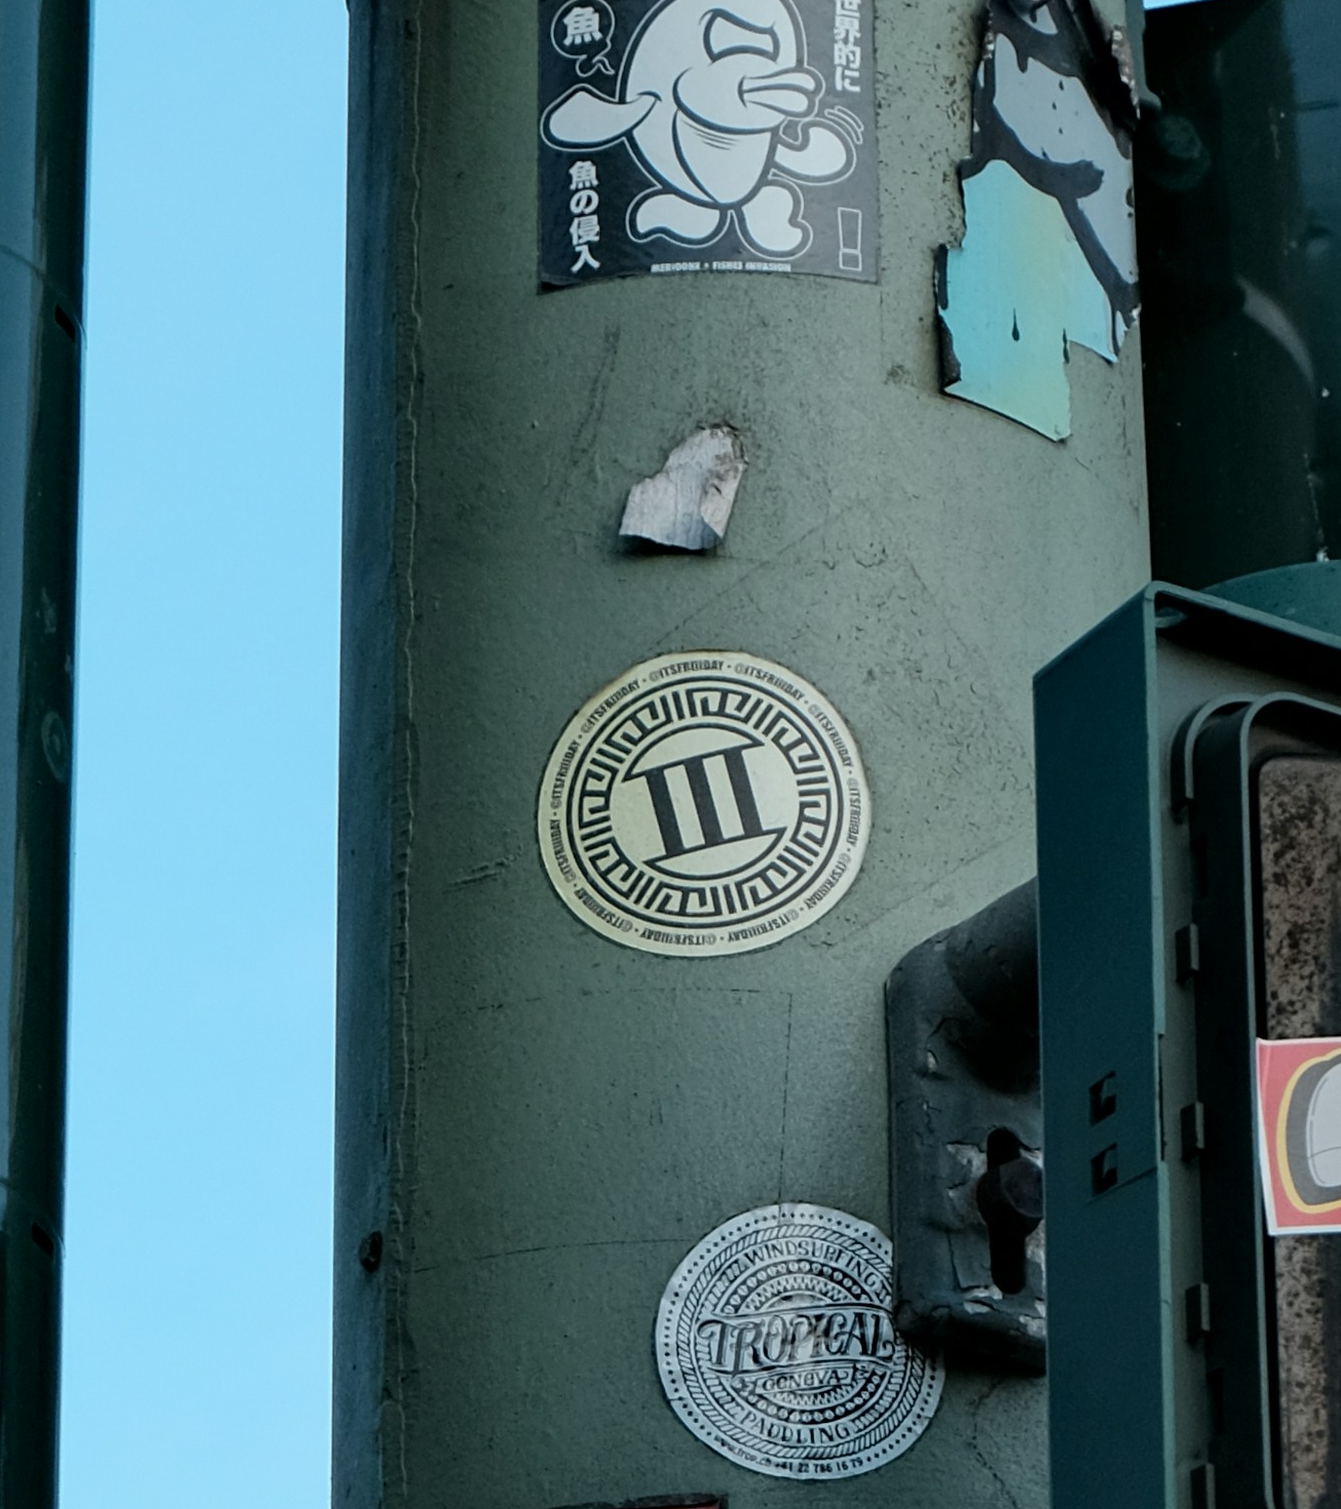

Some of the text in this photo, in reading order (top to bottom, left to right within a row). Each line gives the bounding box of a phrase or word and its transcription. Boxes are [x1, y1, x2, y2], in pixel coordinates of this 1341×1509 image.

[563, 6, 602, 46] 魚
[569, 160, 600, 273] 魚の侵入
[697, 1312, 896, 1373] TROPICAL
[741, 1411, 850, 1442] PADDLING
